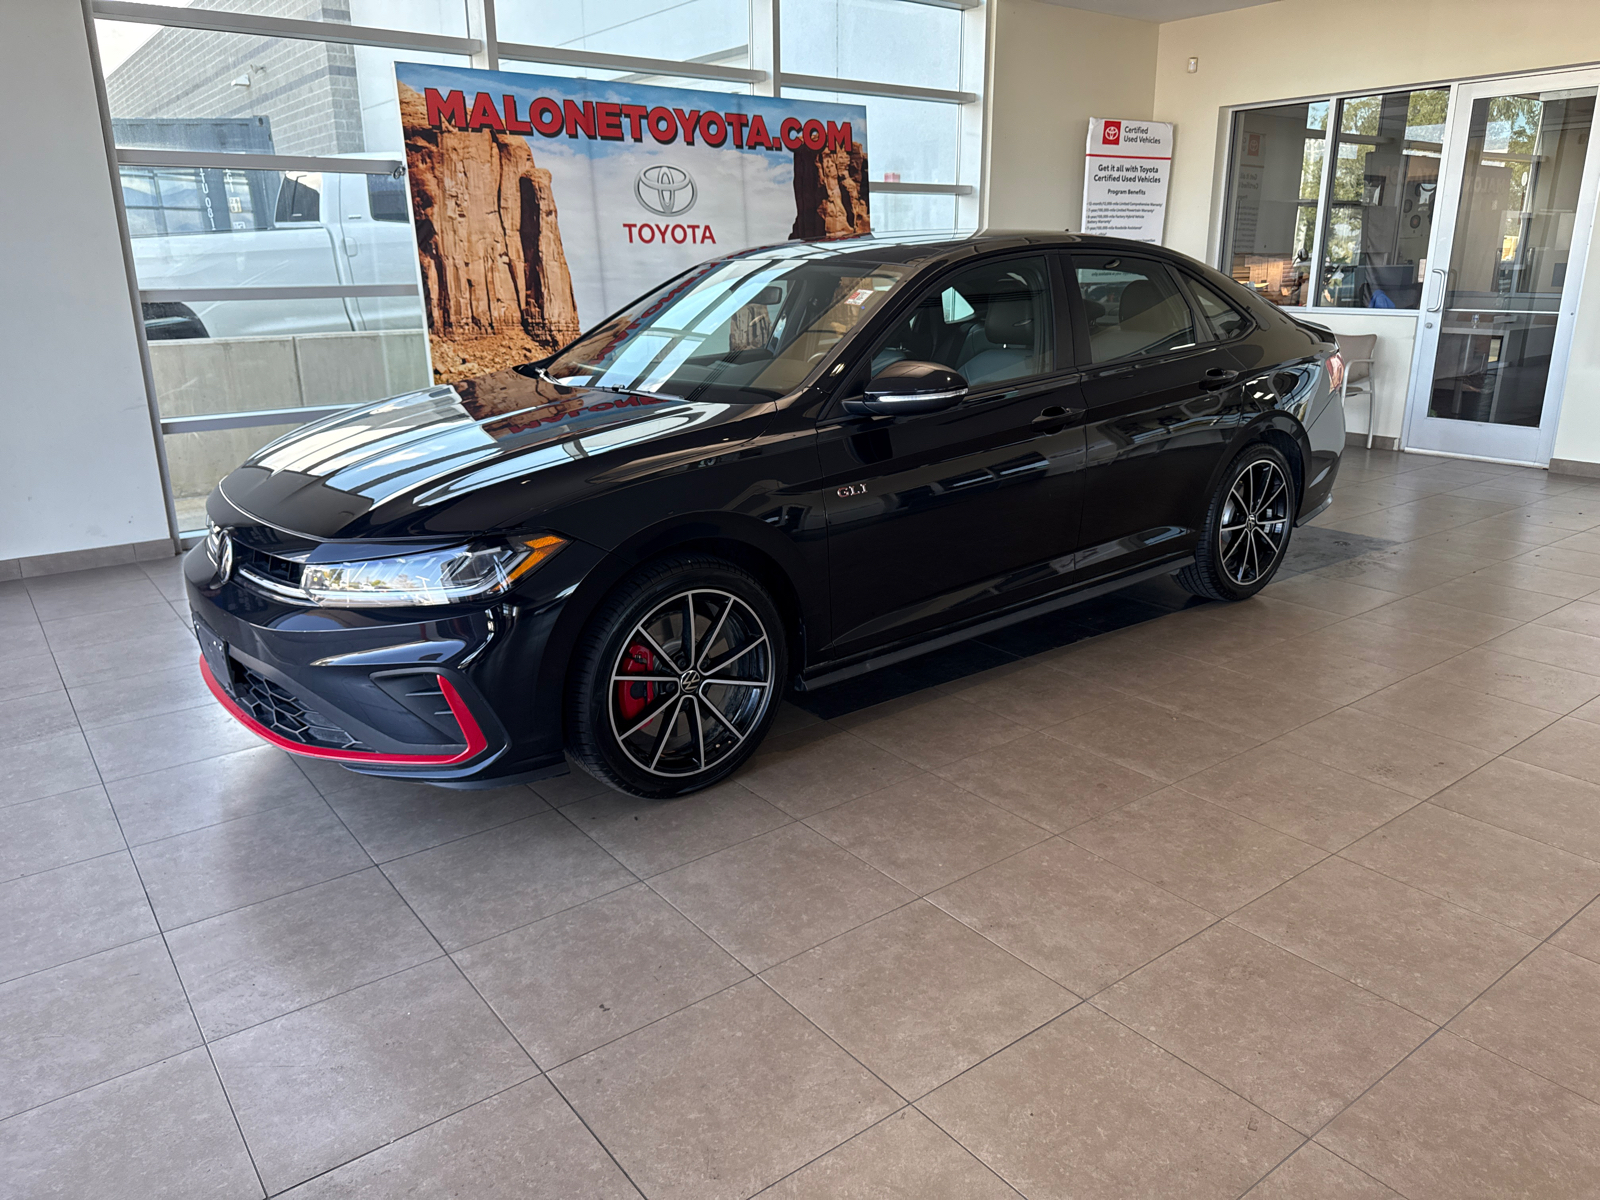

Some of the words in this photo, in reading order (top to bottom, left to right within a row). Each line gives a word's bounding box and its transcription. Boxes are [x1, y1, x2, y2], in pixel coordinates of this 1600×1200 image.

[424, 87, 853, 152] MALONETOYOTA.COM
[1124, 126, 1149, 134] Certified
[1123, 135, 1138, 143] Used
[1139, 136, 1161, 144] Vehicles
[1098, 164, 1109, 172] Get
[1110, 164, 1115, 172] it
[1116, 164, 1124, 172] all
[1125, 165, 1138, 173] with
[1139, 165, 1159, 175] Toyota
[1093, 174, 1120, 182] Certified
[1121, 175, 1137, 183] Used
[1137, 175, 1161, 184] Vehicles
[1107, 188, 1127, 196] Program
[622, 223, 717, 245] TOYOTA
[836, 483, 868, 498] GLI
